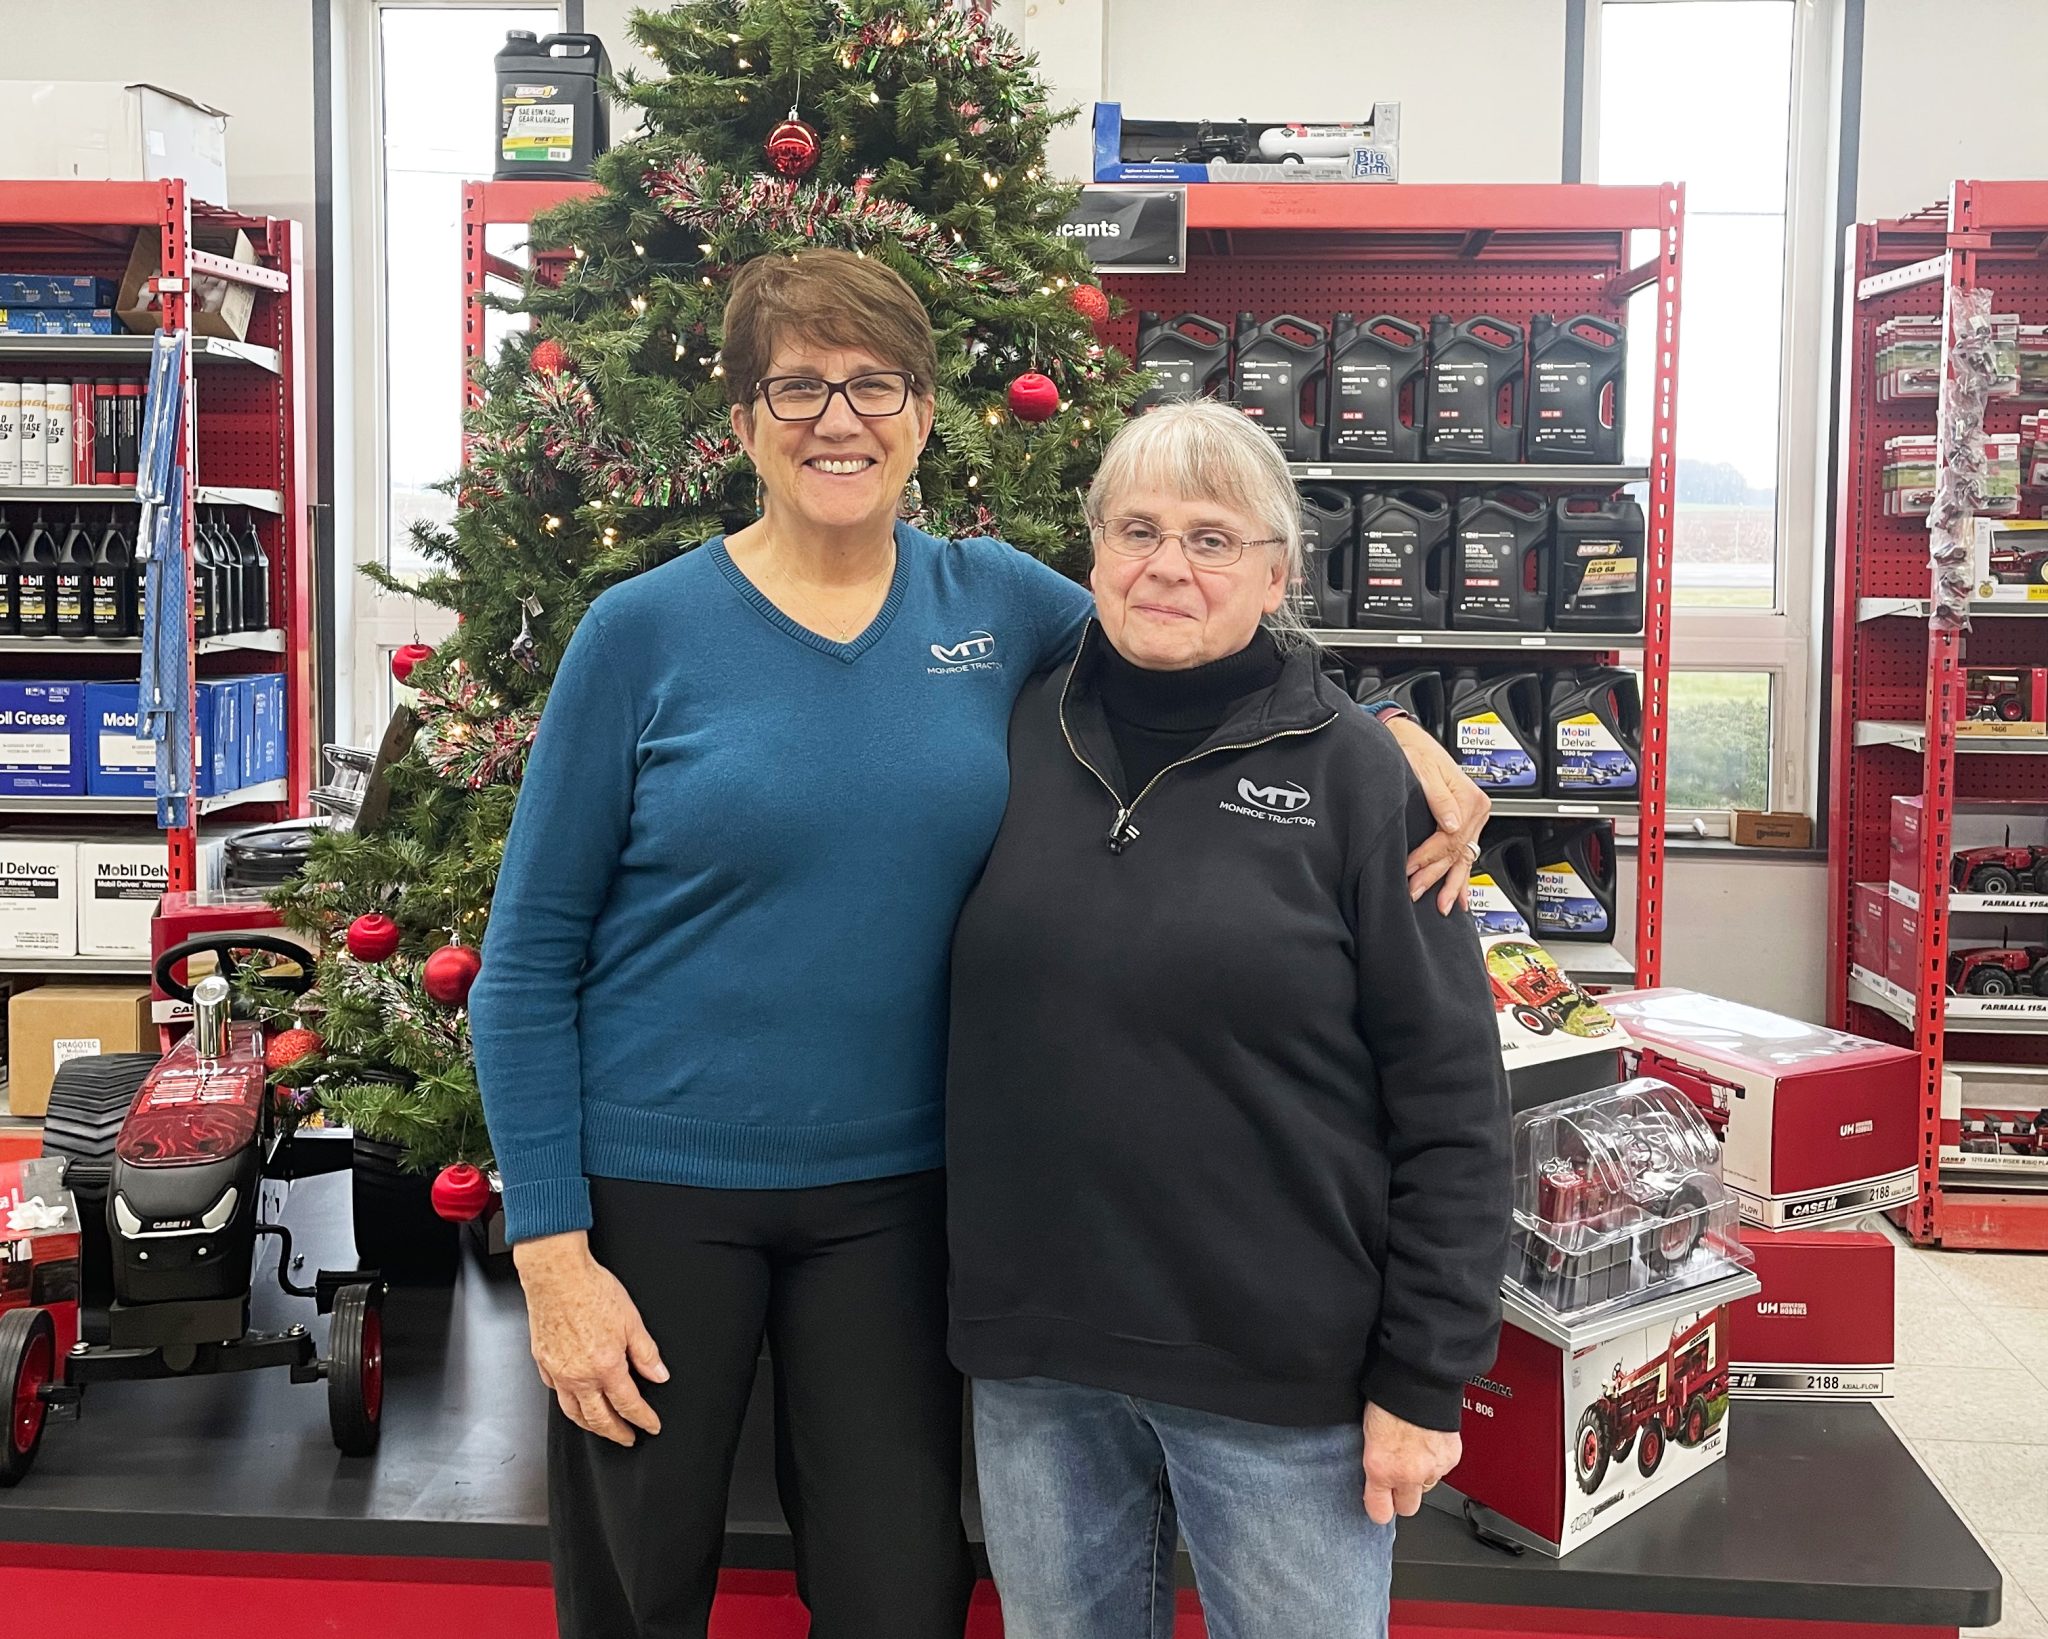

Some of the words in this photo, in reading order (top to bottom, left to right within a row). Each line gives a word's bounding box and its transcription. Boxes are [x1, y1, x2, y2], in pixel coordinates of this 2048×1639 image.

[535, 116, 569, 124] LUBRICANT
[1355, 150, 1386, 168] Big
[1354, 163, 1389, 176] farm
[927, 664, 969, 675] MONROE
[15, 711, 66, 725] Grease
[103, 713, 139, 727] Mobi
[1462, 726, 1490, 735] Mobil
[1562, 727, 1591, 737] Mobil
[1461, 736, 1496, 746] Delvac
[1561, 738, 1597, 748] Delvac
[1219, 801, 1266, 820] MONROE
[1267, 813, 1317, 828] TRACTOR
[7, 863, 57, 875] Delvac
[98, 864, 137, 876] Mobil
[141, 864, 169, 877] Delv
[1467, 889, 1485, 898] obil
[1537, 884, 1569, 895] Delvac
[1982, 900, 2027, 908] FARMALL
[172, 1005, 195, 1015] CA
[1981, 1003, 2026, 1011] FARMALL
[57, 1041, 98, 1049] DRAGOTEC
[1840, 1123, 1855, 1137] UH
[1792, 1200, 1826, 1217] CASE
[1869, 1185, 1890, 1201] 2188
[152, 1221, 180, 1229] CASE
[1756, 1302, 1779, 1314] UH
[1471, 1375, 1513, 1398] RMALL
[1807, 1376, 1839, 1389] 2188
[1475, 1402, 1494, 1418] 806
